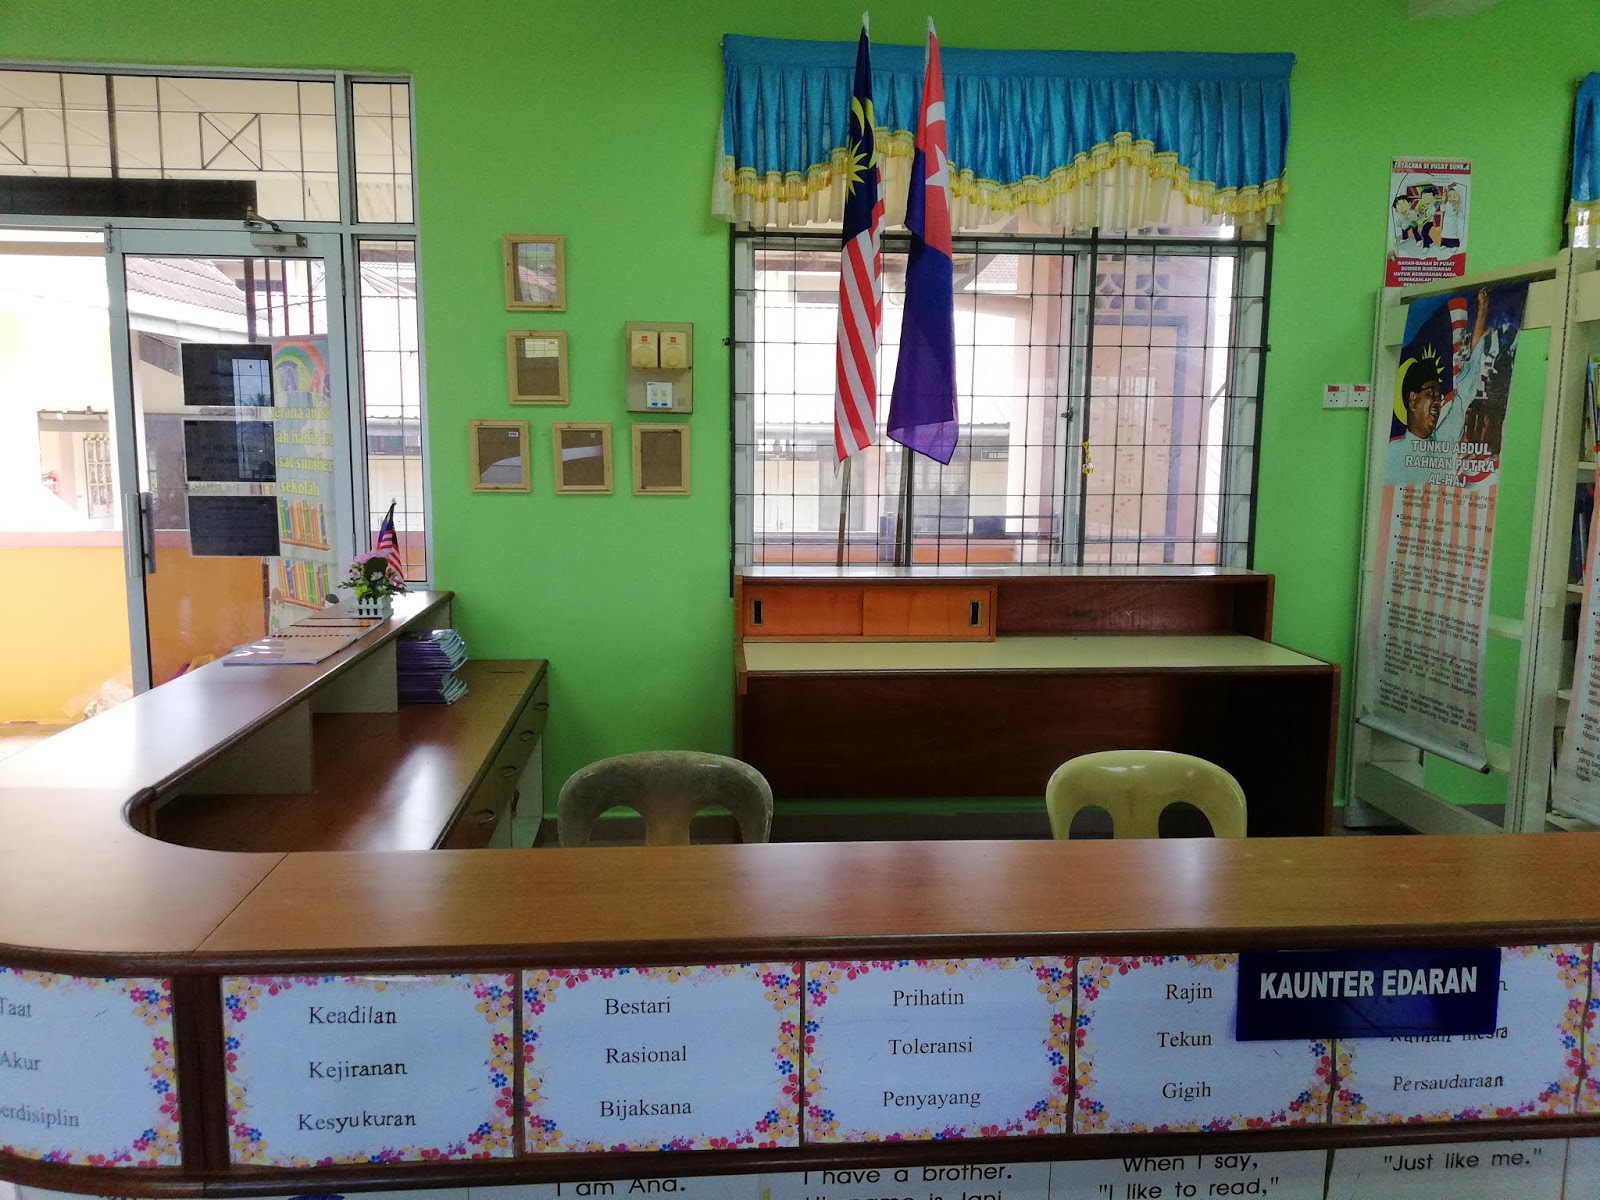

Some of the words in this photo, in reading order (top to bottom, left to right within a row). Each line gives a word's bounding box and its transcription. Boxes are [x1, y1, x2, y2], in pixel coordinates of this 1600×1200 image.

[1411, 440, 1450, 453] TUNKU
[1453, 441, 1492, 456] ABDUL
[1405, 455, 1453, 471] RAHMAN
[1455, 458, 1496, 474] PUTRA
[279, 478, 320, 497] sekolah
[1428, 472, 1467, 489] AL-HAJ
[1260, 969, 1374, 999] KAUNTER
[1382, 966, 1478, 996] EDARAN
[893, 988, 965, 1007] Prihatin
[1165, 982, 1213, 1003] Rajin
[309, 1005, 398, 1026] Keadilan
[604, 997, 671, 1016] Bestari
[888, 1036, 973, 1055] Toleransi
[1156, 1030, 1213, 1048] Tekun
[0, 1051, 41, 1071] Akur
[605, 1045, 687, 1064] Rasional
[309, 1060, 408, 1083] Kejiranan
[1162, 1081, 1212, 1103] Gigih
[1393, 1074, 1504, 1092] Persaudaraan
[883, 1089, 981, 1111] Penyayang
[600, 1099, 693, 1122] Bijaksana
[299, 1110, 417, 1134] Kesyukuran
[1122, 1157, 1185, 1173] When
[1214, 1154, 1258, 1171] say,
[1384, 1154, 1434, 1172] "Just
[1445, 1153, 1479, 1169] like
[1491, 1148, 1542, 1167] me."
[822, 1170, 881, 1185] have
[894, 1168, 909, 1183] a
[923, 1164, 1013, 1181] brother.
[576, 1182, 615, 1196] am
[1127, 1183, 1162, 1200] like
[1175, 1181, 1197, 1197] to
[1209, 1176, 1280, 1196] read,"
